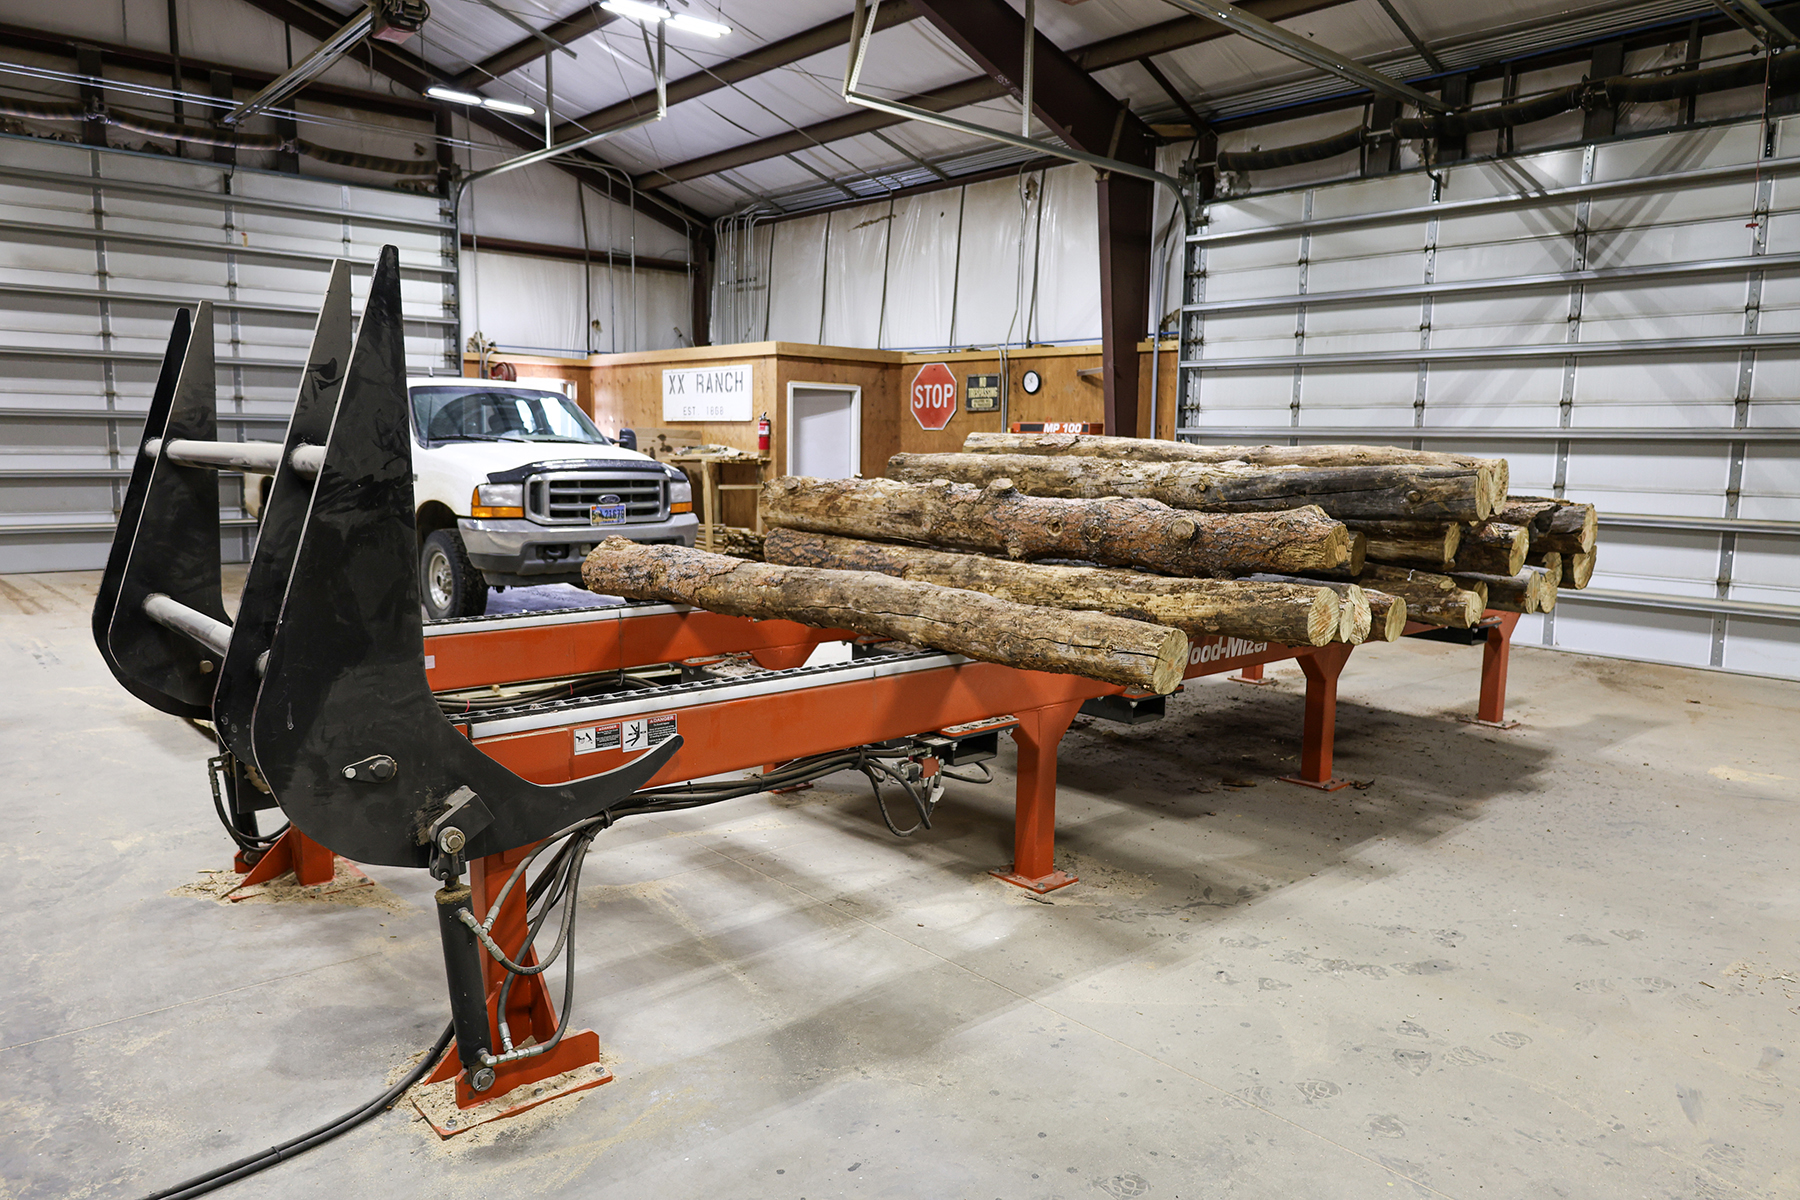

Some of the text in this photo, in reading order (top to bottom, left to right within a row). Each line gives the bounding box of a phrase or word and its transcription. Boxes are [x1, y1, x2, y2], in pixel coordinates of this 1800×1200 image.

[669, 371, 744, 395] XX RANCH
[914, 383, 954, 409] STOP
[683, 405, 700, 416] EST.
[1043, 422, 1083, 433] MP 100
